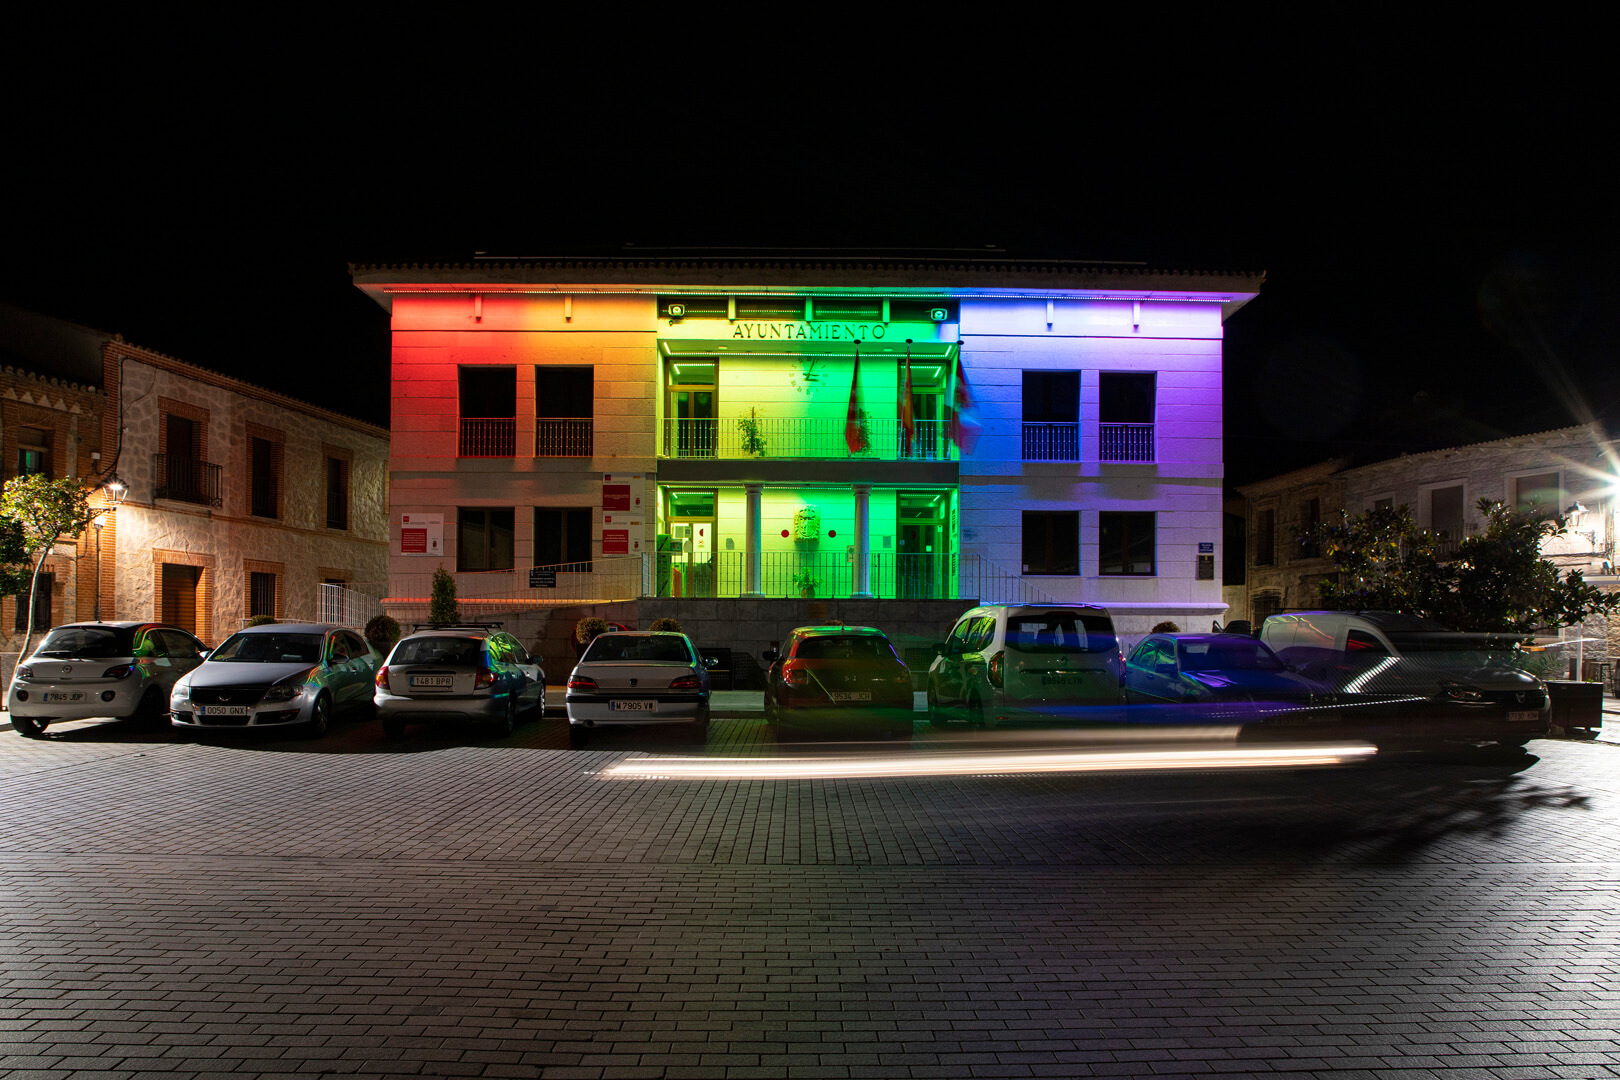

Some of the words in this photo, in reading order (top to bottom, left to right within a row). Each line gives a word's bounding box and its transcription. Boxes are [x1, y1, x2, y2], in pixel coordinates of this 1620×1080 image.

[732, 323, 885, 340] AYUNTAMIENTO
[416, 677, 433, 685] 1481
[49, 693, 68, 701] 7845
[834, 692, 852, 700] 9534
[622, 702, 642, 710] 7905
[207, 706, 226, 715] 0050
[229, 706, 245, 715] GNX
